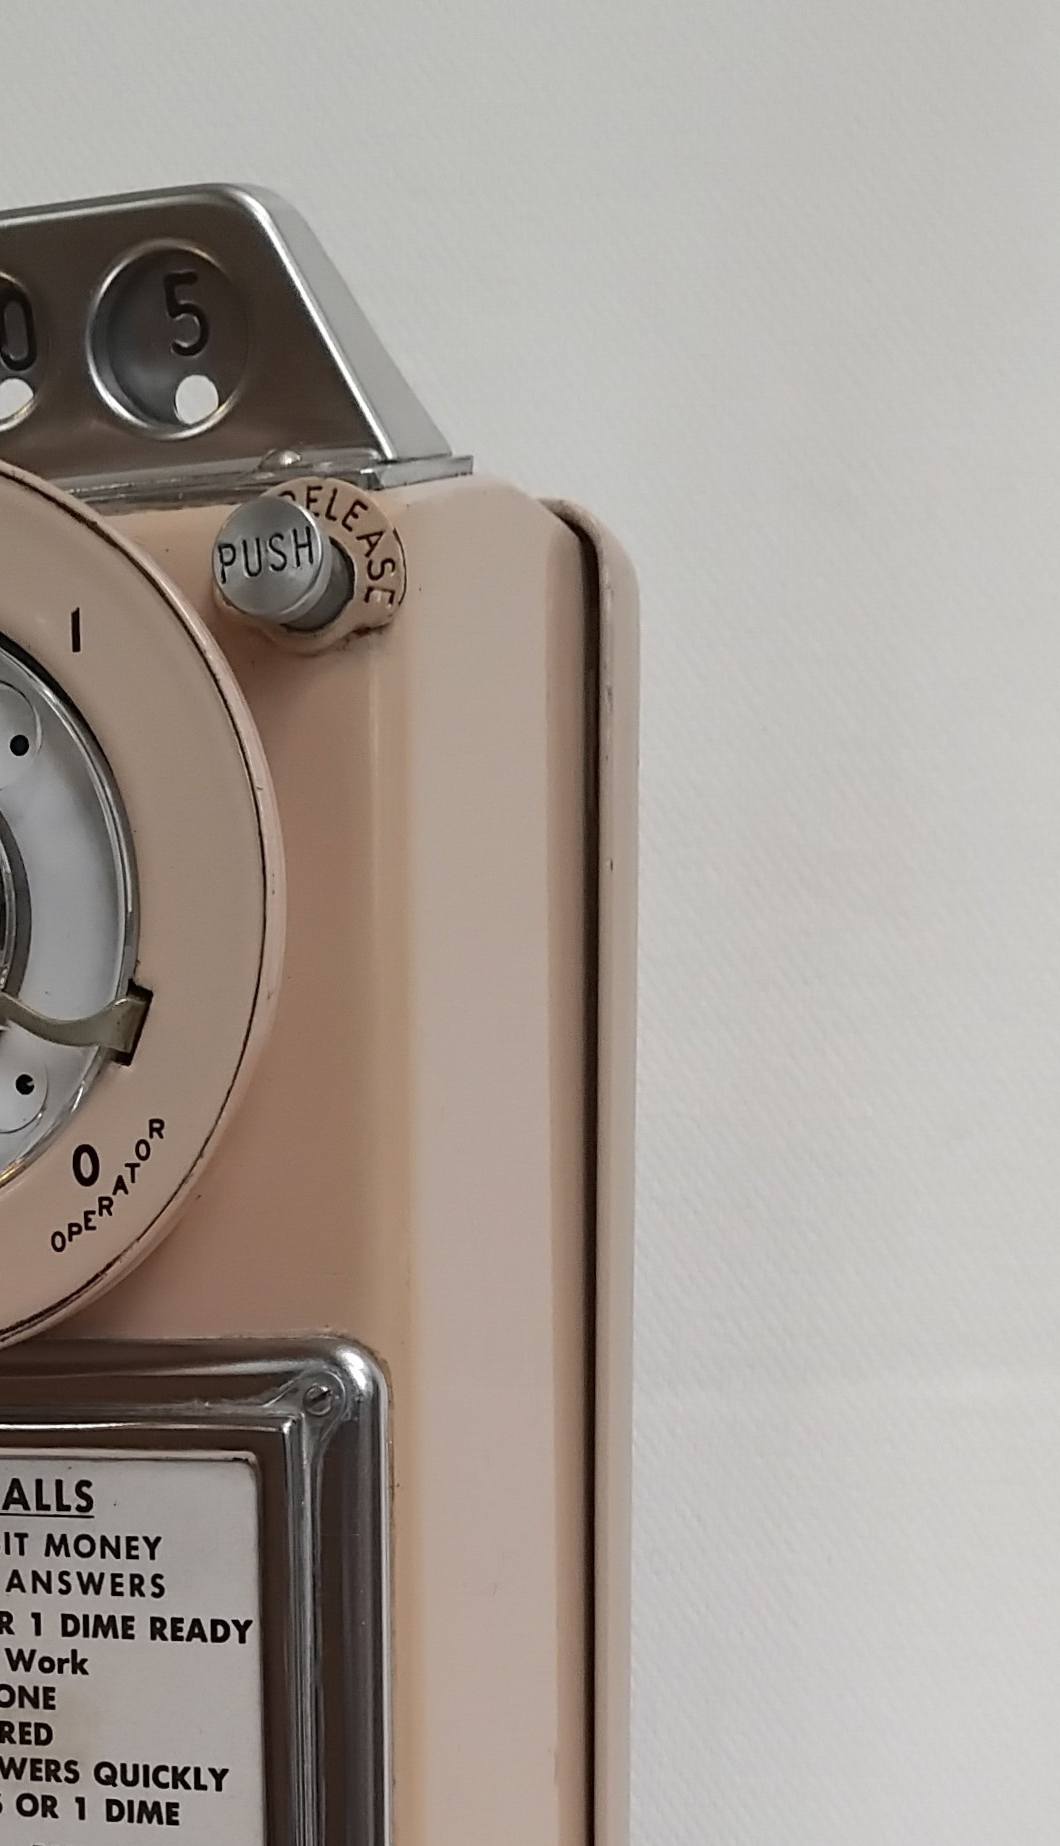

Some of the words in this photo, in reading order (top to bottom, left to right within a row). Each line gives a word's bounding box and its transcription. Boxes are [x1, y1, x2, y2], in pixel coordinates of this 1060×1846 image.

[163, 270, 210, 357] 5
[217, 525, 314, 585] PUSH
[278, 484, 397, 607] ELEASE
[71, 608, 81, 652] 1
[50, 1118, 165, 1253] OPERATOR
[44, 1533, 162, 1560] MONEY
[5, 1569, 166, 1598] ANSWERS
[31, 1612, 42, 1636] 1
[61, 1613, 135, 1640] DIME
[150, 1616, 253, 1644] READY
[5, 1648, 89, 1675] Work
[93, 1761, 229, 1792] QUICKLY
[15, 1793, 59, 1819] OR
[74, 1796, 86, 1821] 1
[105, 1798, 180, 1826] DIME
